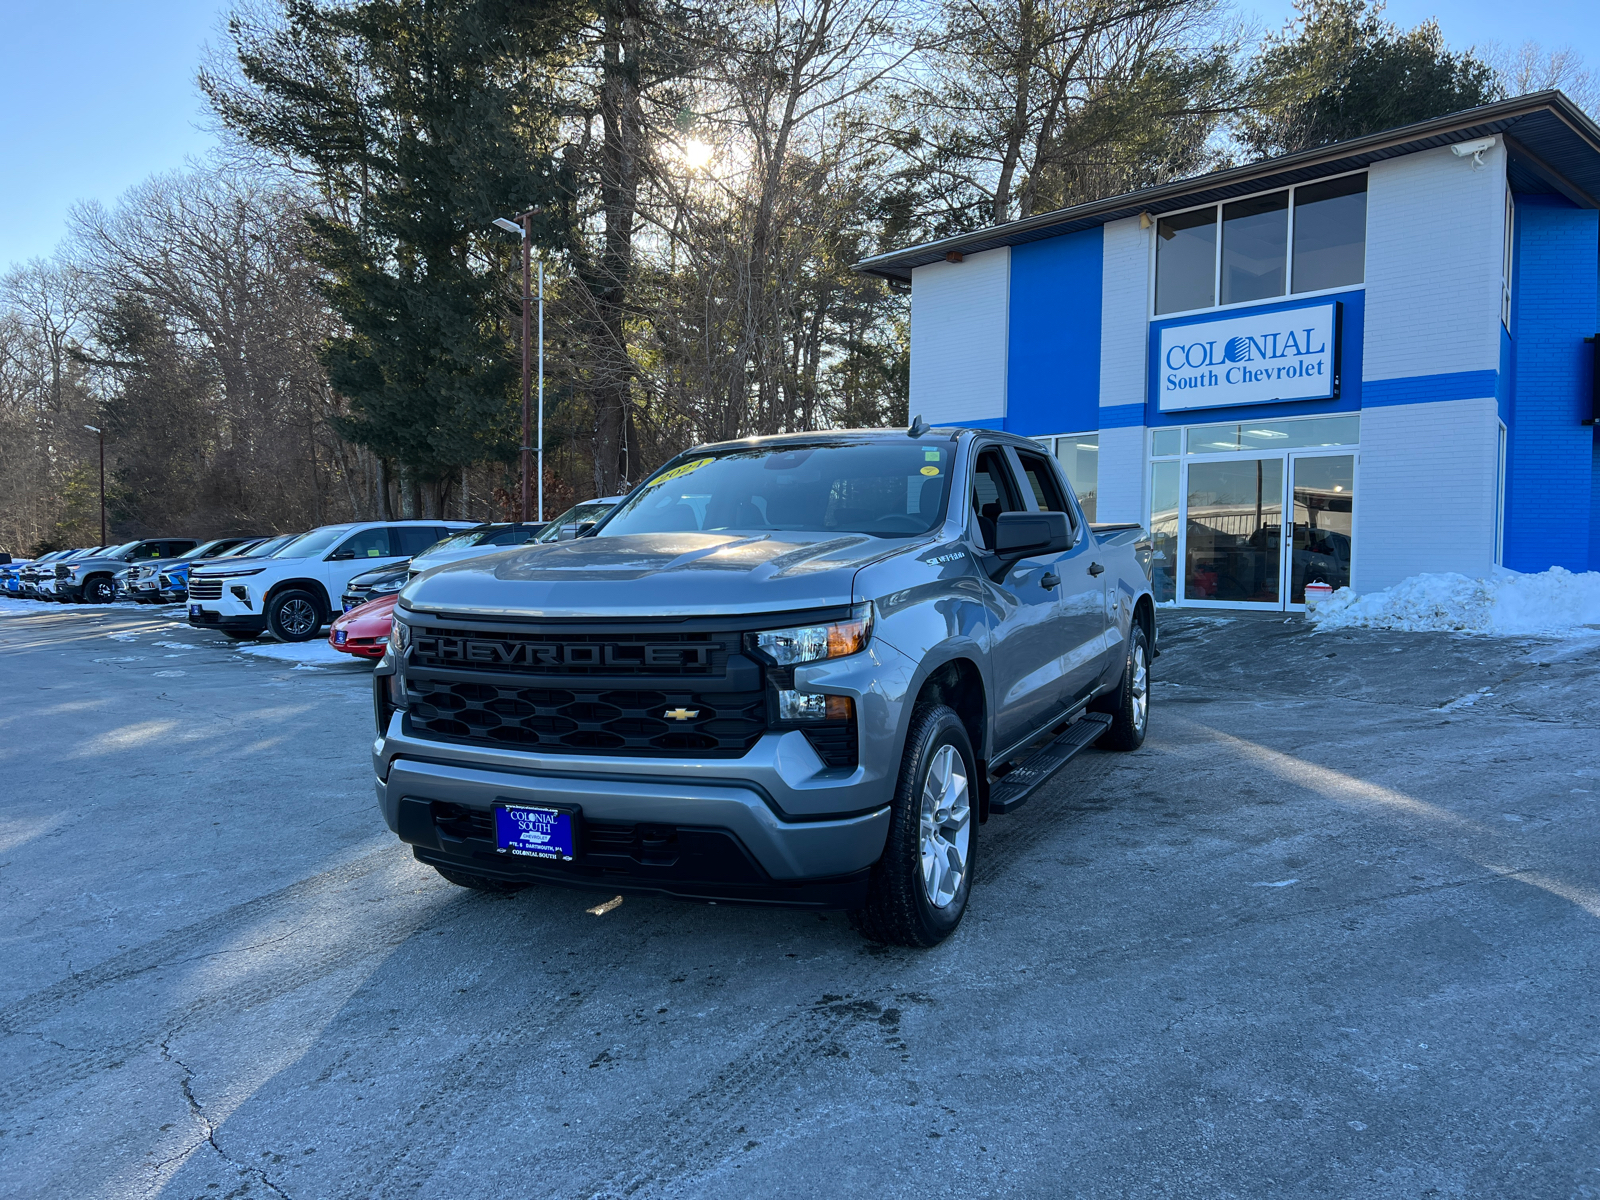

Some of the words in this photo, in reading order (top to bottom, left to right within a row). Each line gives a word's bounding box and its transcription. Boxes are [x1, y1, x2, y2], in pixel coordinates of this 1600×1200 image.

[1166, 328, 1325, 370] COLONIAL
[1166, 370, 1219, 391] South
[1225, 359, 1325, 385] Chevrolet
[413, 636, 723, 665] CHEVROLET
[510, 811, 558, 825] COLONIAL
[518, 820, 551, 833] SOUTH
[522, 833, 548, 841] CHEVROLET
[512, 849, 538, 857] COLONIAL
[539, 852, 557, 860] SOUTH
